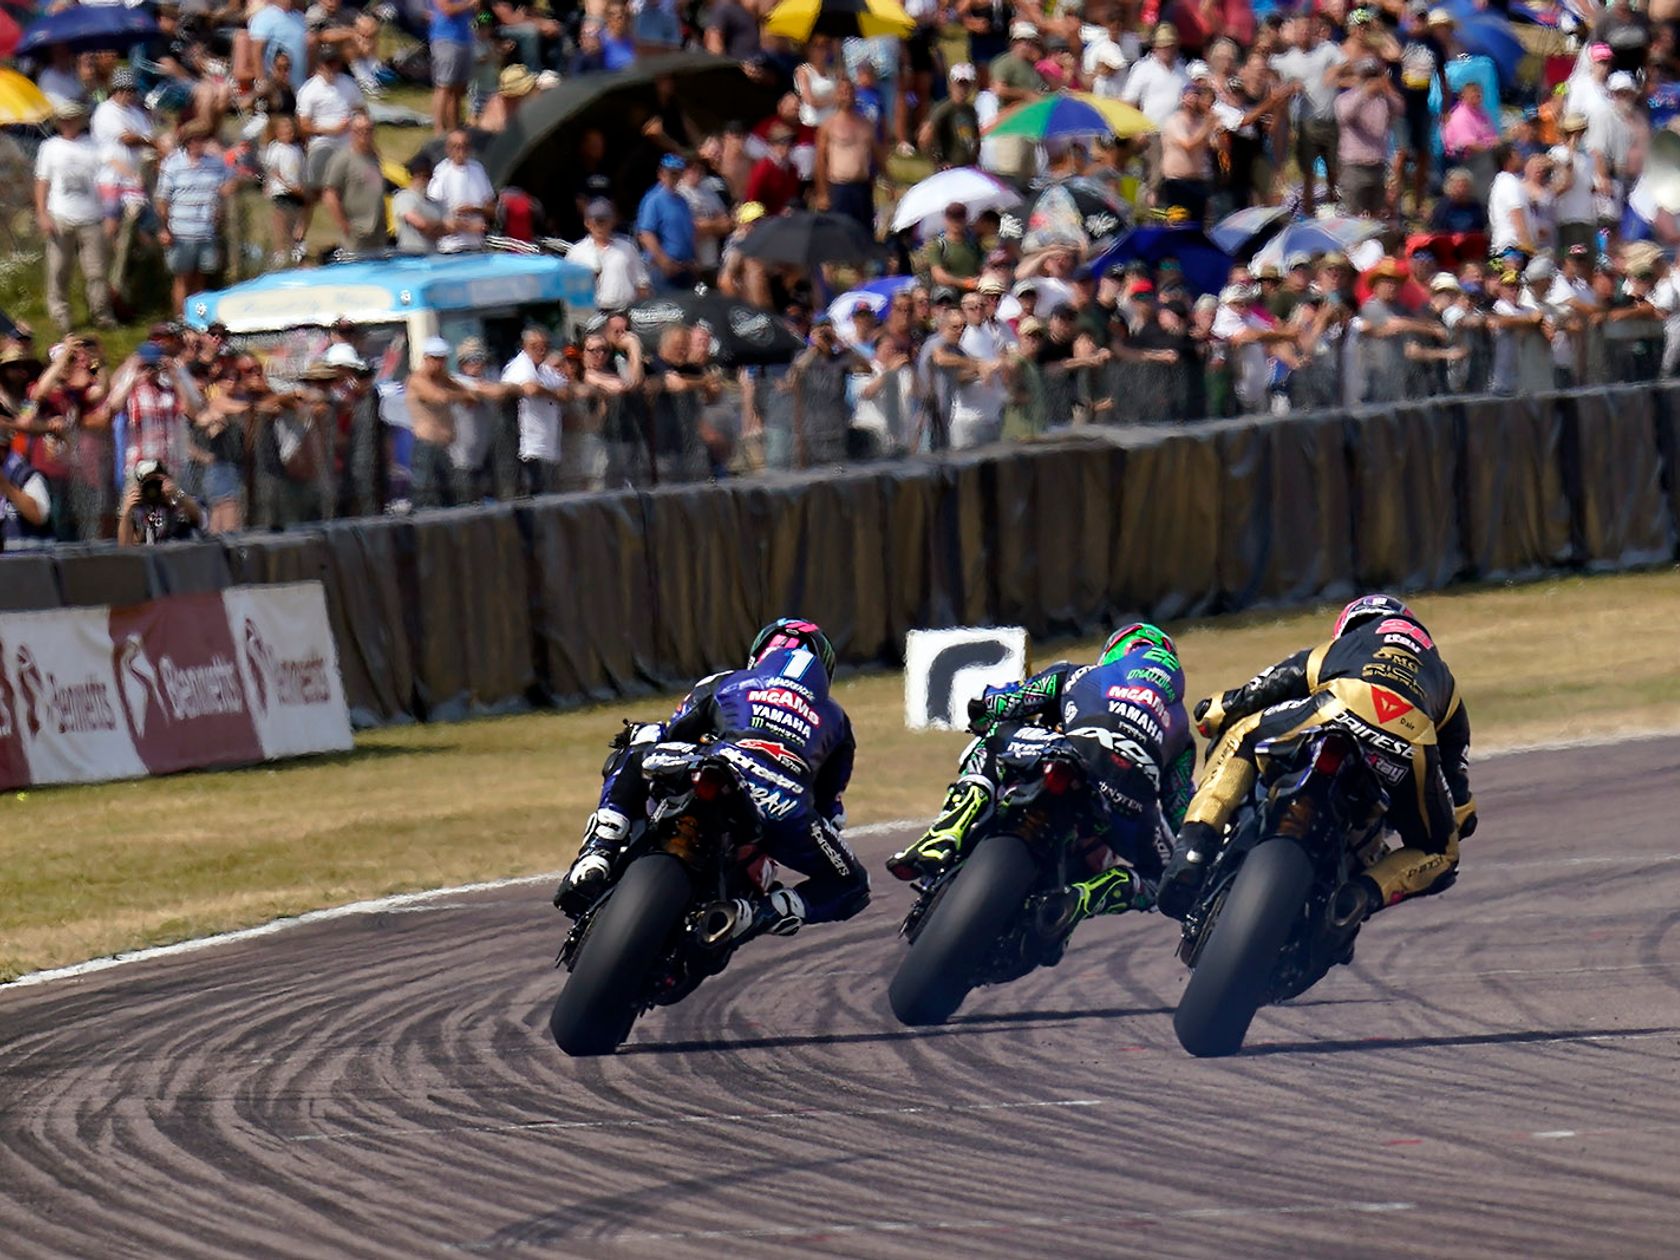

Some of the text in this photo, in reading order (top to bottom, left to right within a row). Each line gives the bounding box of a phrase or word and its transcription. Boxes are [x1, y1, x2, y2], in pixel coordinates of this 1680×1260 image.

[780, 644, 816, 681] 1
[1142, 647, 1180, 672] 22
[751, 703, 811, 739] YAMAHA
[1108, 700, 1164, 745] YAMAHA
